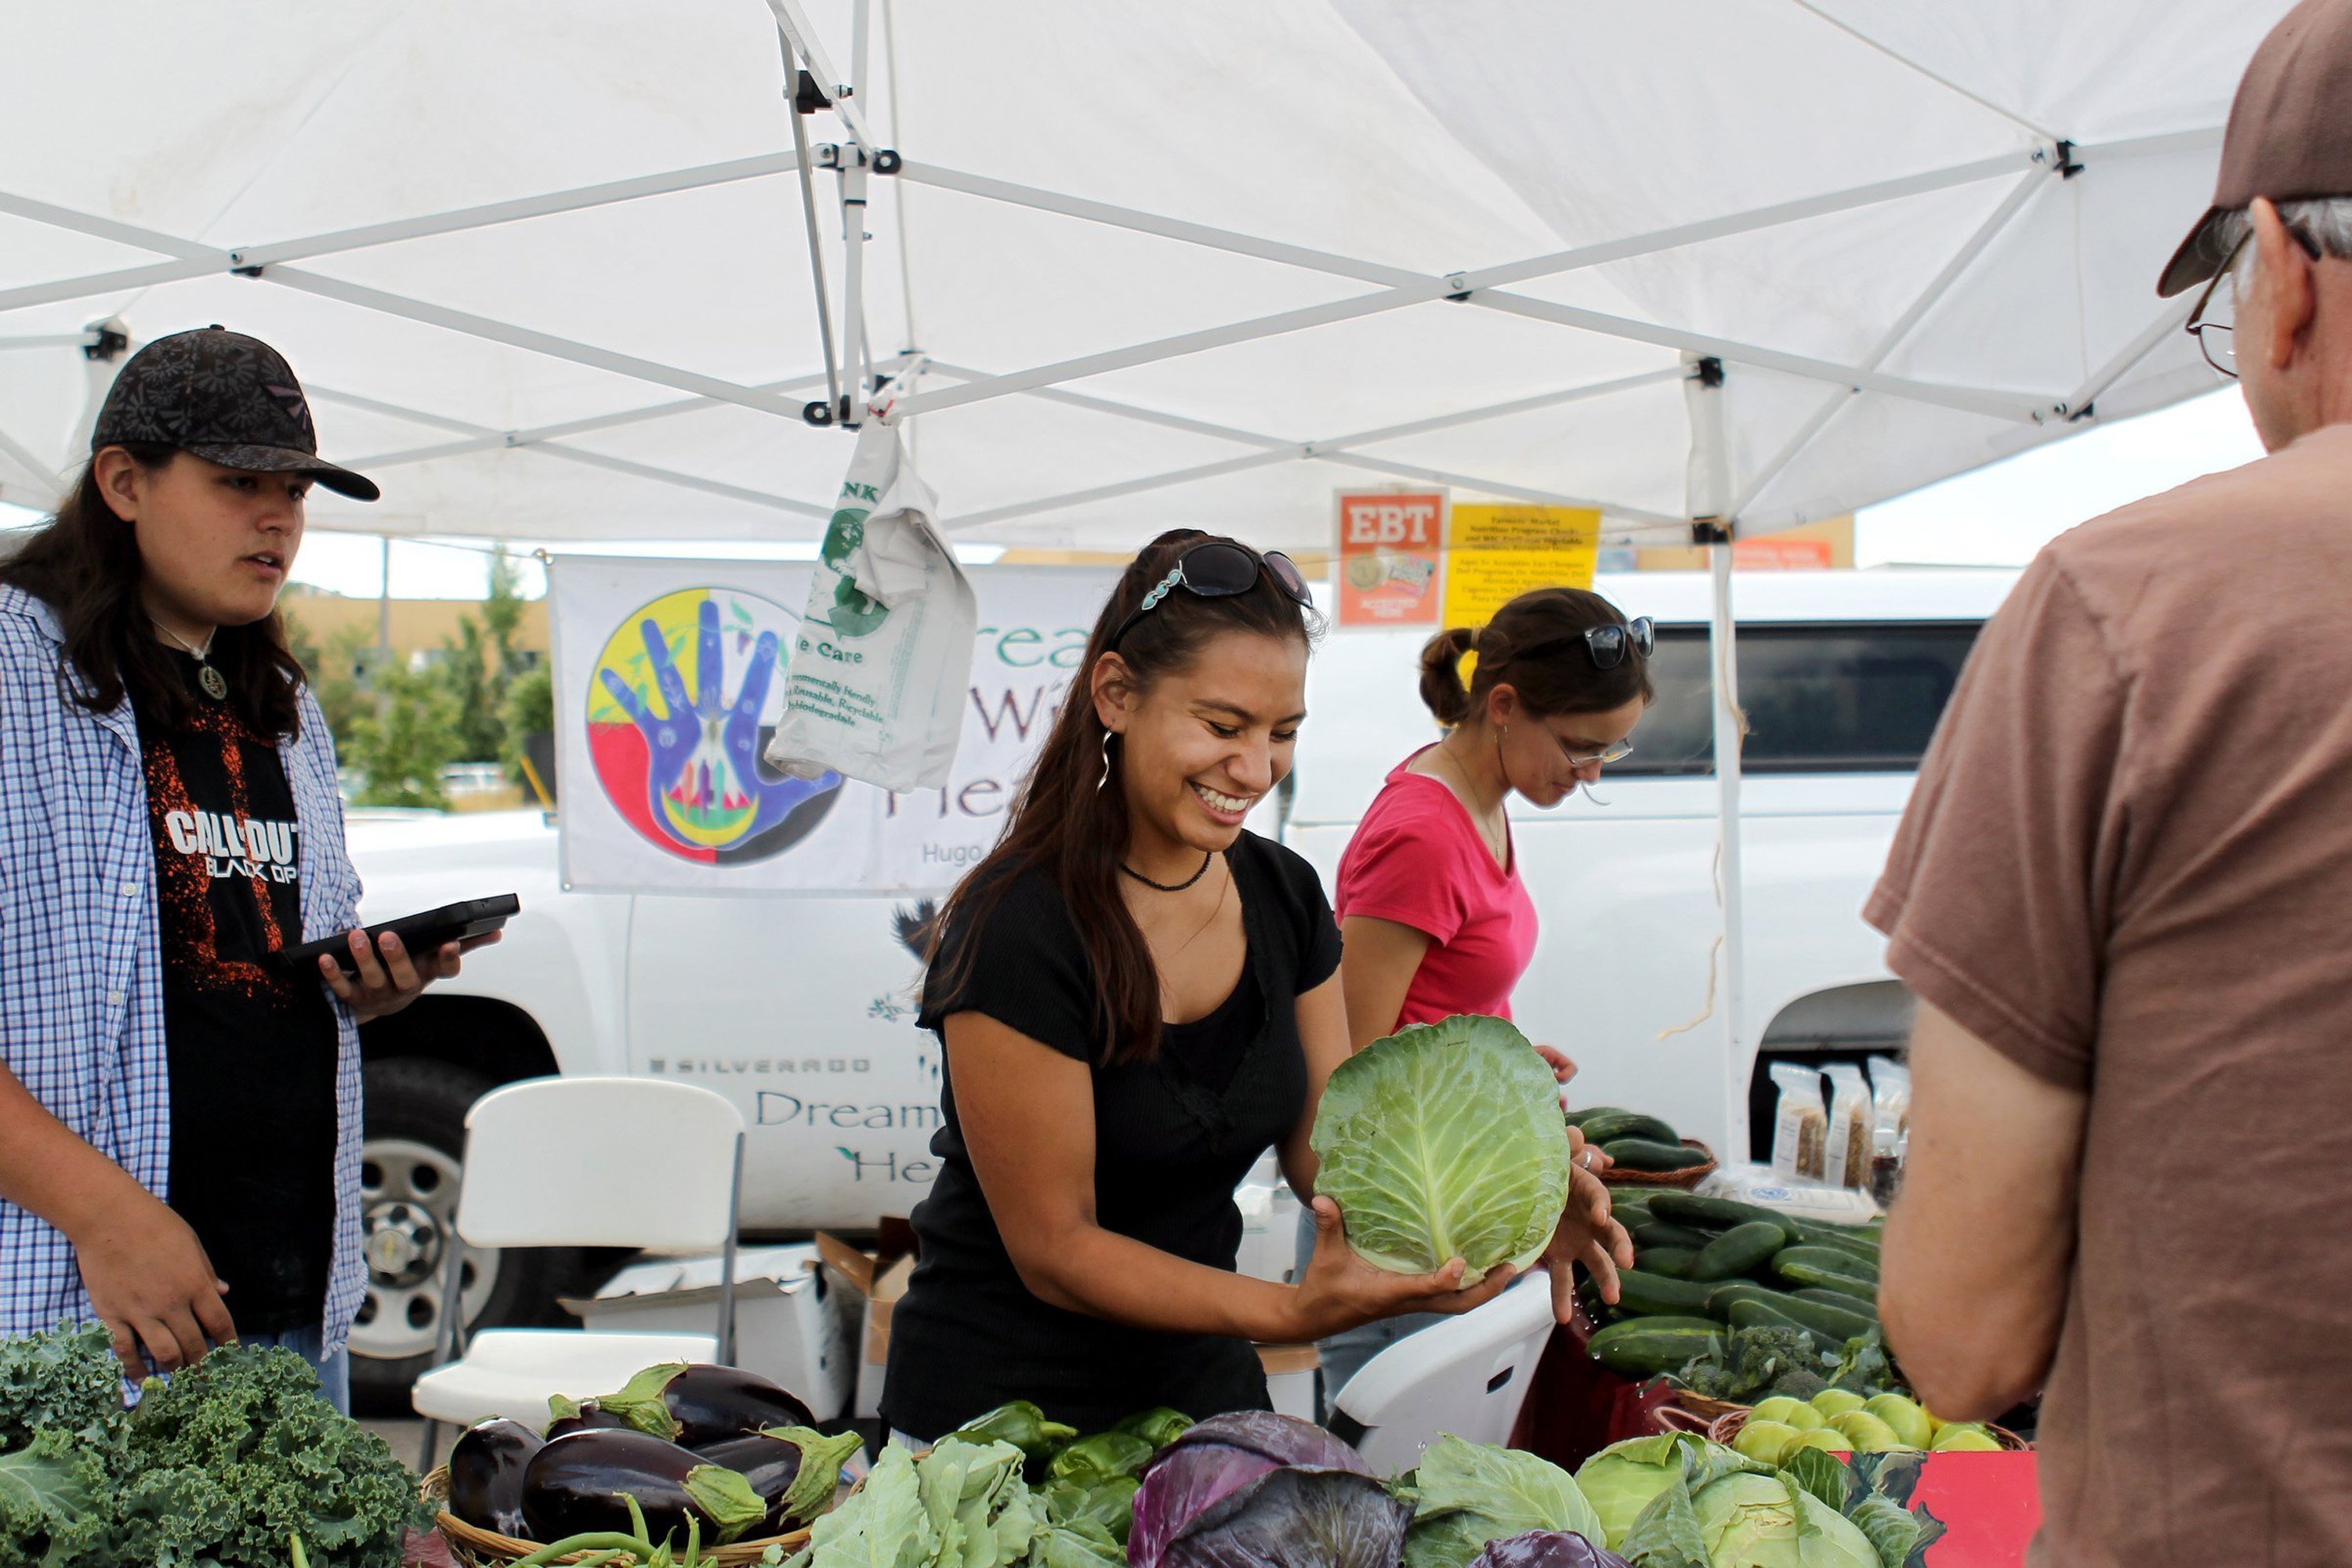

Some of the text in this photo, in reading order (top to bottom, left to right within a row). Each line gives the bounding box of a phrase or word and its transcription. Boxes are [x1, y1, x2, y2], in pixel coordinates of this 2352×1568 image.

[1349, 505, 1434, 542] EBT
[817, 642, 863, 664] Care
[165, 811, 246, 857] CALL
[205, 856, 270, 882] BLACK
[676, 1059, 871, 1074] SILVERADO
